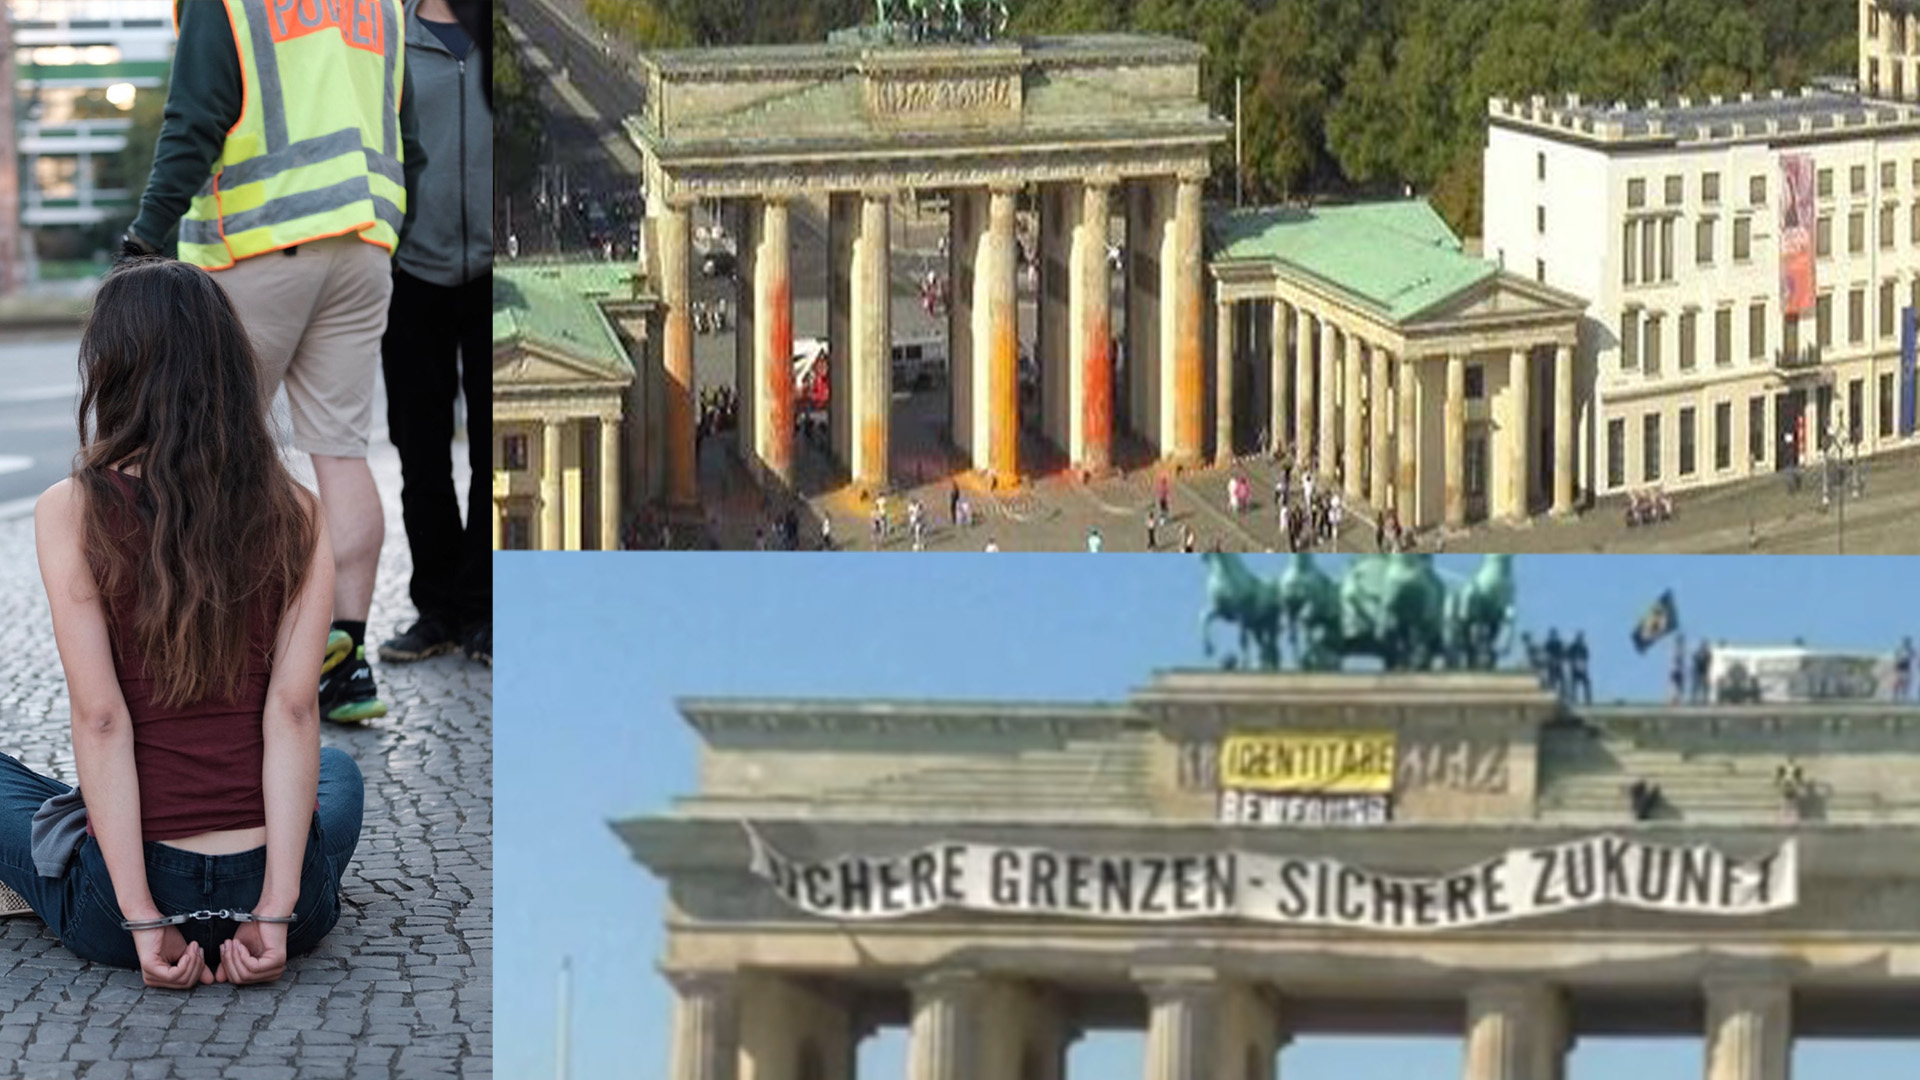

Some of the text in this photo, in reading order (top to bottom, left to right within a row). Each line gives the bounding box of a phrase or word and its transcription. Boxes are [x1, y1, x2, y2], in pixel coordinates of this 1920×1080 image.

[273, 0, 378, 48] POLEI
[990, 850, 1236, 912] GRENZEN
[1278, 857, 1509, 926] SICHERE
